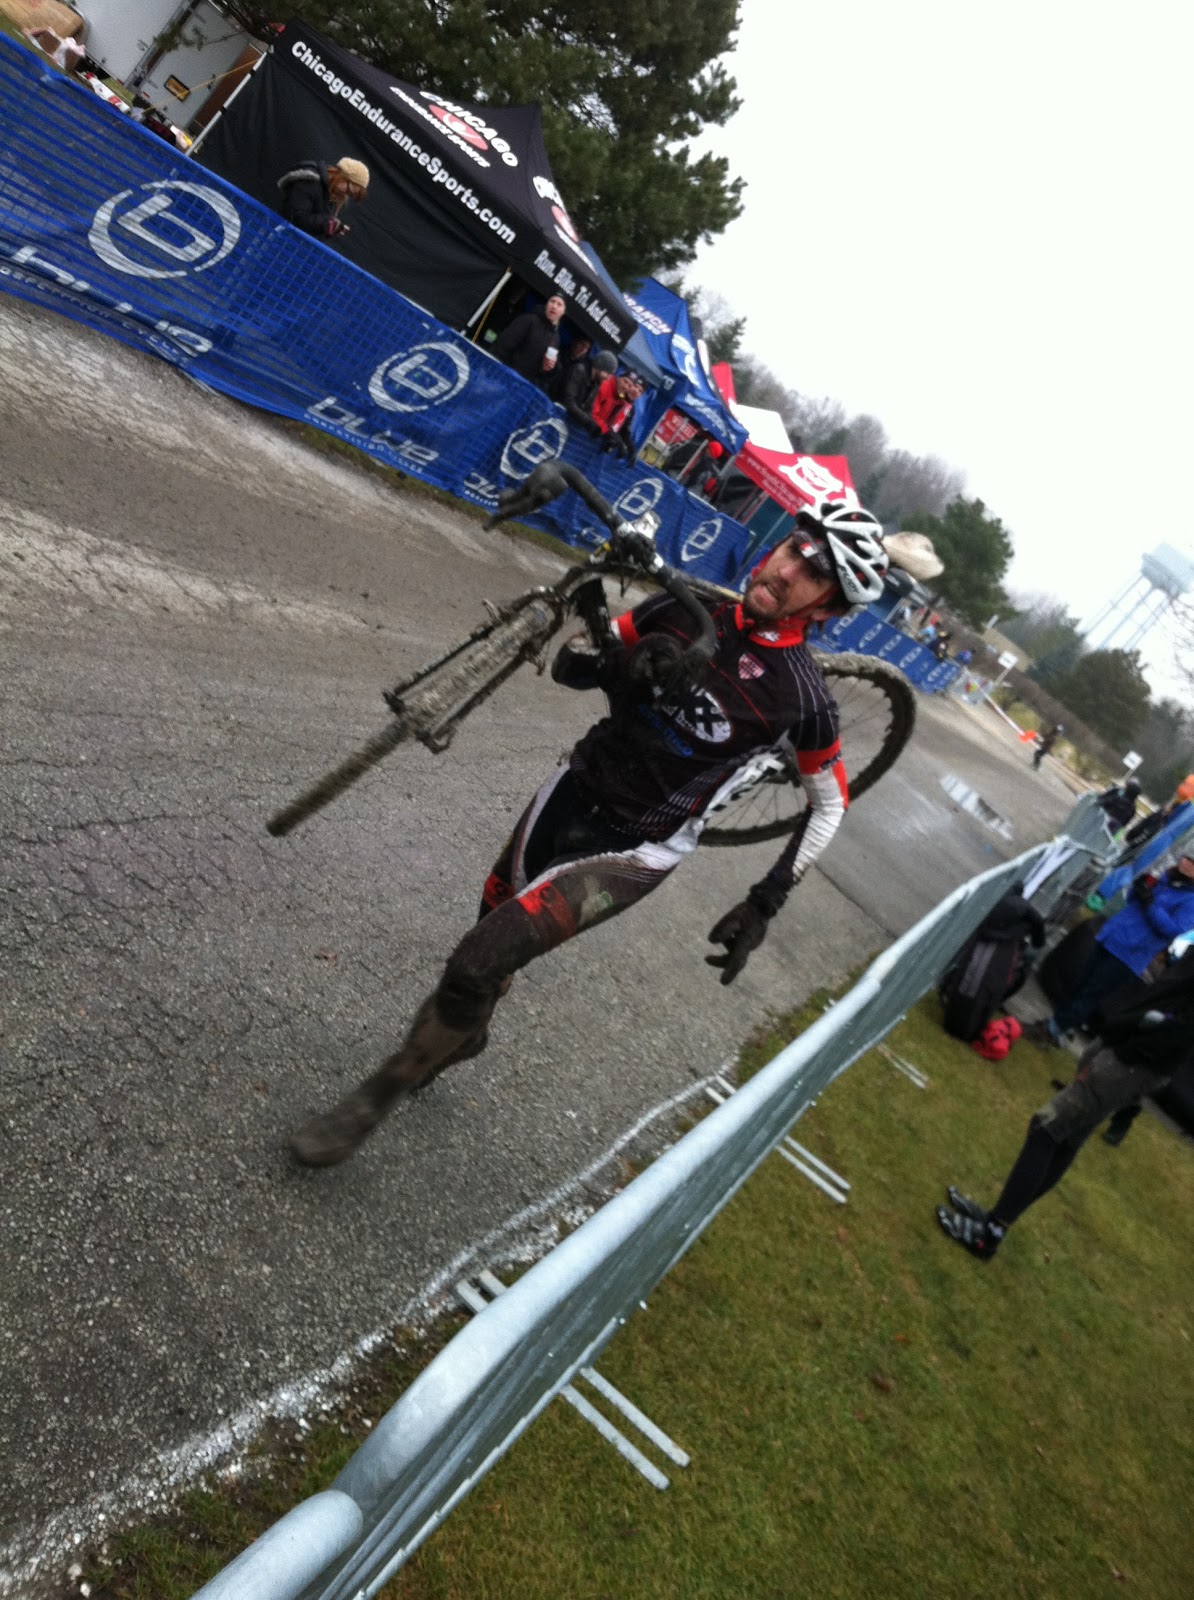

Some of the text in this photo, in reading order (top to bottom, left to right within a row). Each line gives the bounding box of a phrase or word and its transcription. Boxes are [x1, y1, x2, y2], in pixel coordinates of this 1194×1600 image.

[291, 40, 517, 245] ChicagoEnduranceSports.com
[419, 90, 519, 168] CHICAGO
[448, 135, 491, 169] SPORTS
[534, 249, 556, 278] Run.
[553, 267, 576, 296] Bike.
[586, 299, 607, 322] And
